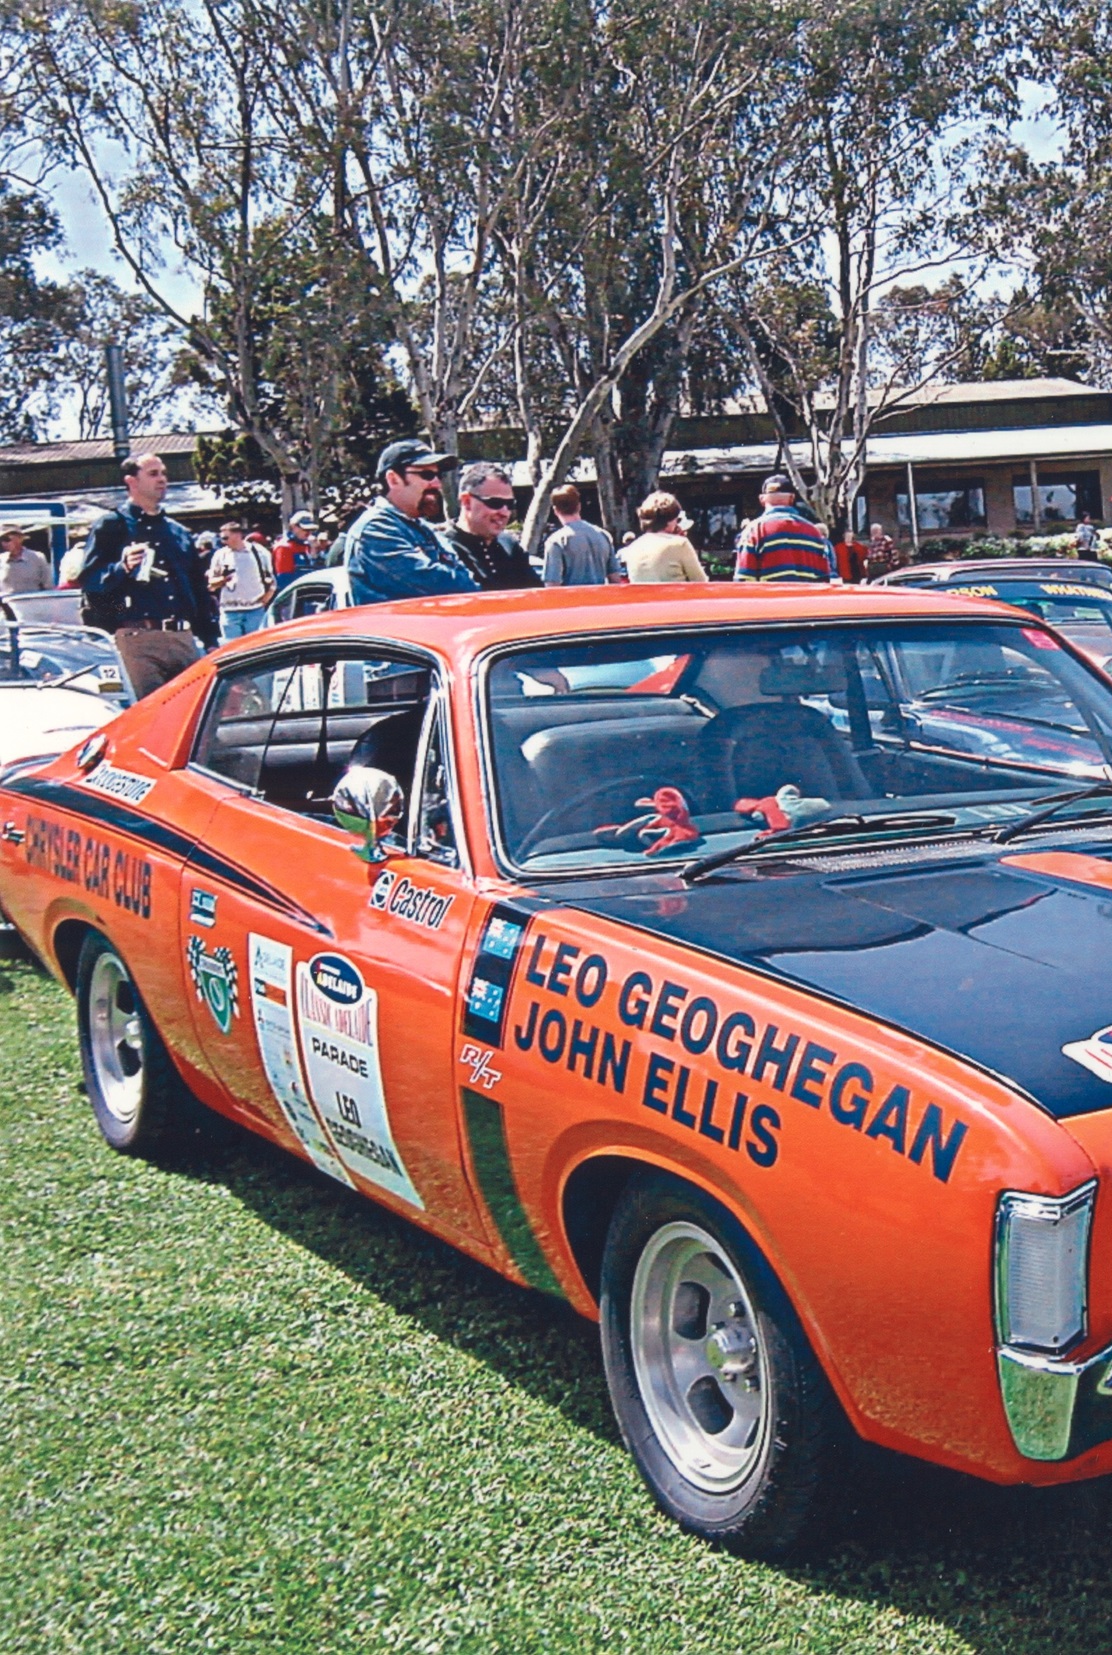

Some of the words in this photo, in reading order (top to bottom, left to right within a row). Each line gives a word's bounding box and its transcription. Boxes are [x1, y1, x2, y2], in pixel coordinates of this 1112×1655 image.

[84, 837, 111, 900] CAR
[114, 850, 153, 920] CLUB
[389, 879, 455, 929] Castrol
[312, 1037, 369, 1078] PARADE
[460, 1044, 502, 1089] R/T
[514, 1001, 631, 1094] JOHN
[642, 1051, 783, 1169] ELLIS
[525, 934, 608, 1008] LEO
[618, 971, 969, 1184] GEOGHEGAN
